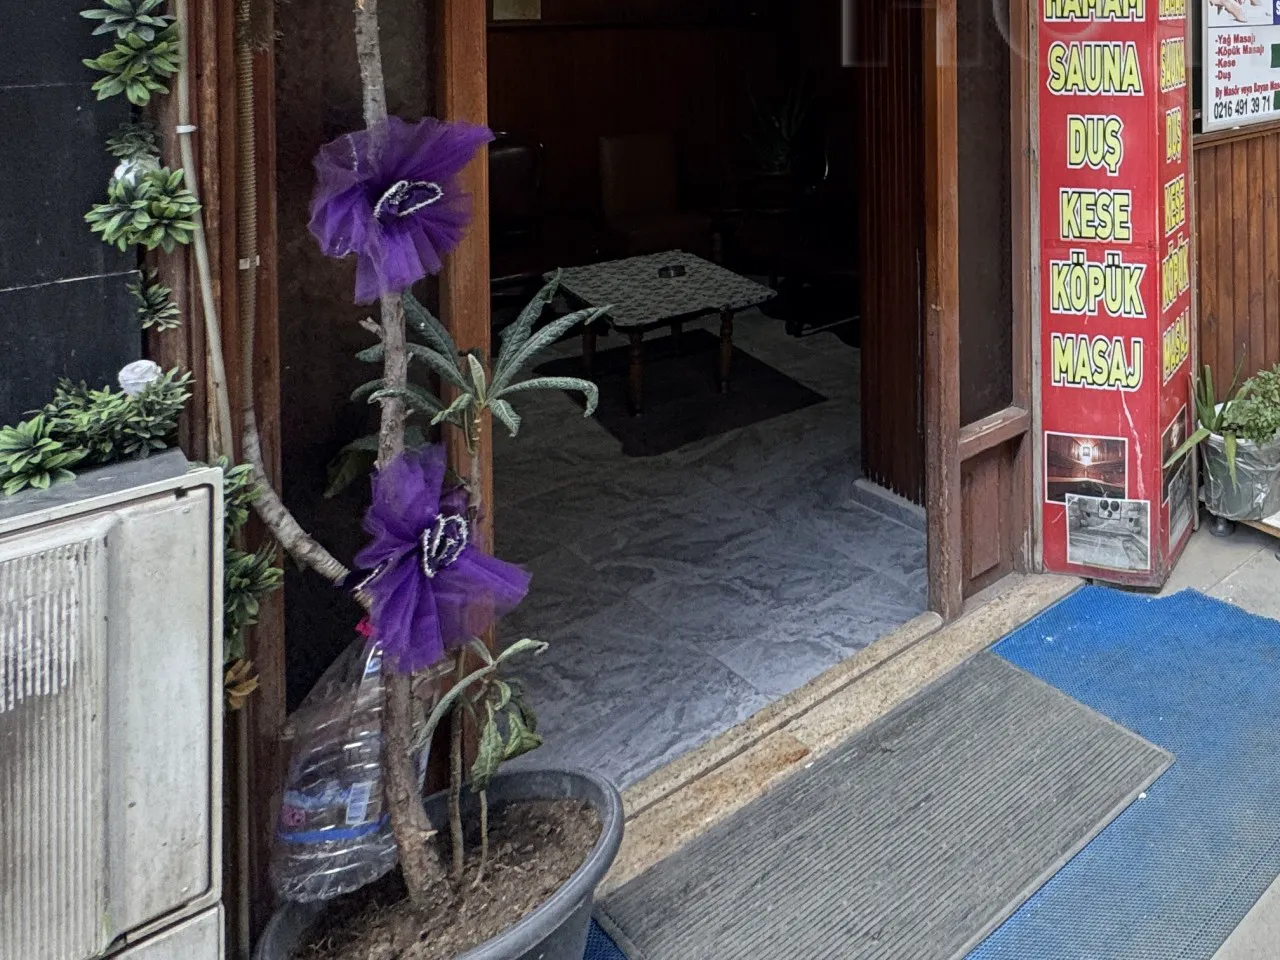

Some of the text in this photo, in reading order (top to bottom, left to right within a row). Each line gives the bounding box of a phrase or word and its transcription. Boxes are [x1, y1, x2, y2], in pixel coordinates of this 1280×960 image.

[1047, 41, 1144, 96] SAUNA
[1214, 95, 1270, 119] 0216 491 39 71
[1067, 115, 1124, 176] DUŞ
[1060, 187, 1132, 242] KESE
[1050, 249, 1147, 318] KÖPÜK
[1051, 333, 1143, 391] MASAJ
